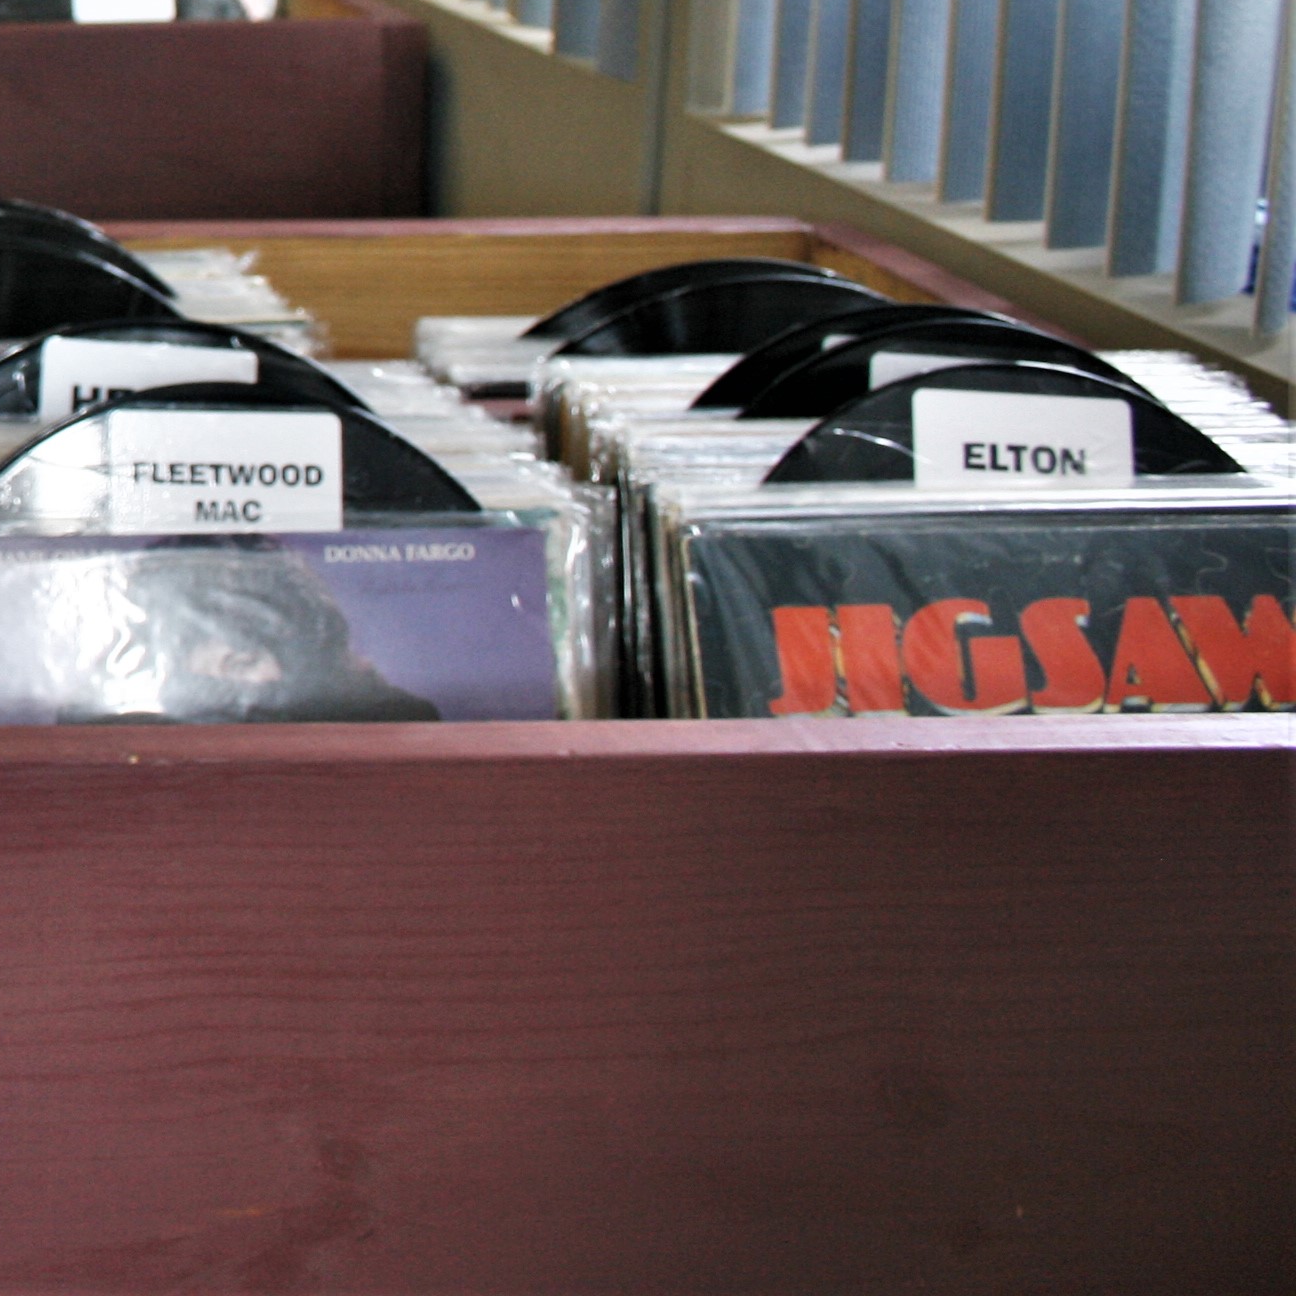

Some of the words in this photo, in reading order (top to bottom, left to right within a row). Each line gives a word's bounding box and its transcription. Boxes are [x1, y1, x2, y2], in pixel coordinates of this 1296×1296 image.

[963, 442, 1088, 474] ELTON
[134, 461, 322, 487] FLEETWOOD
[196, 501, 262, 523] MAC
[325, 546, 402, 563] DONNA
[768, 594, 1296, 716] JIGSAW
